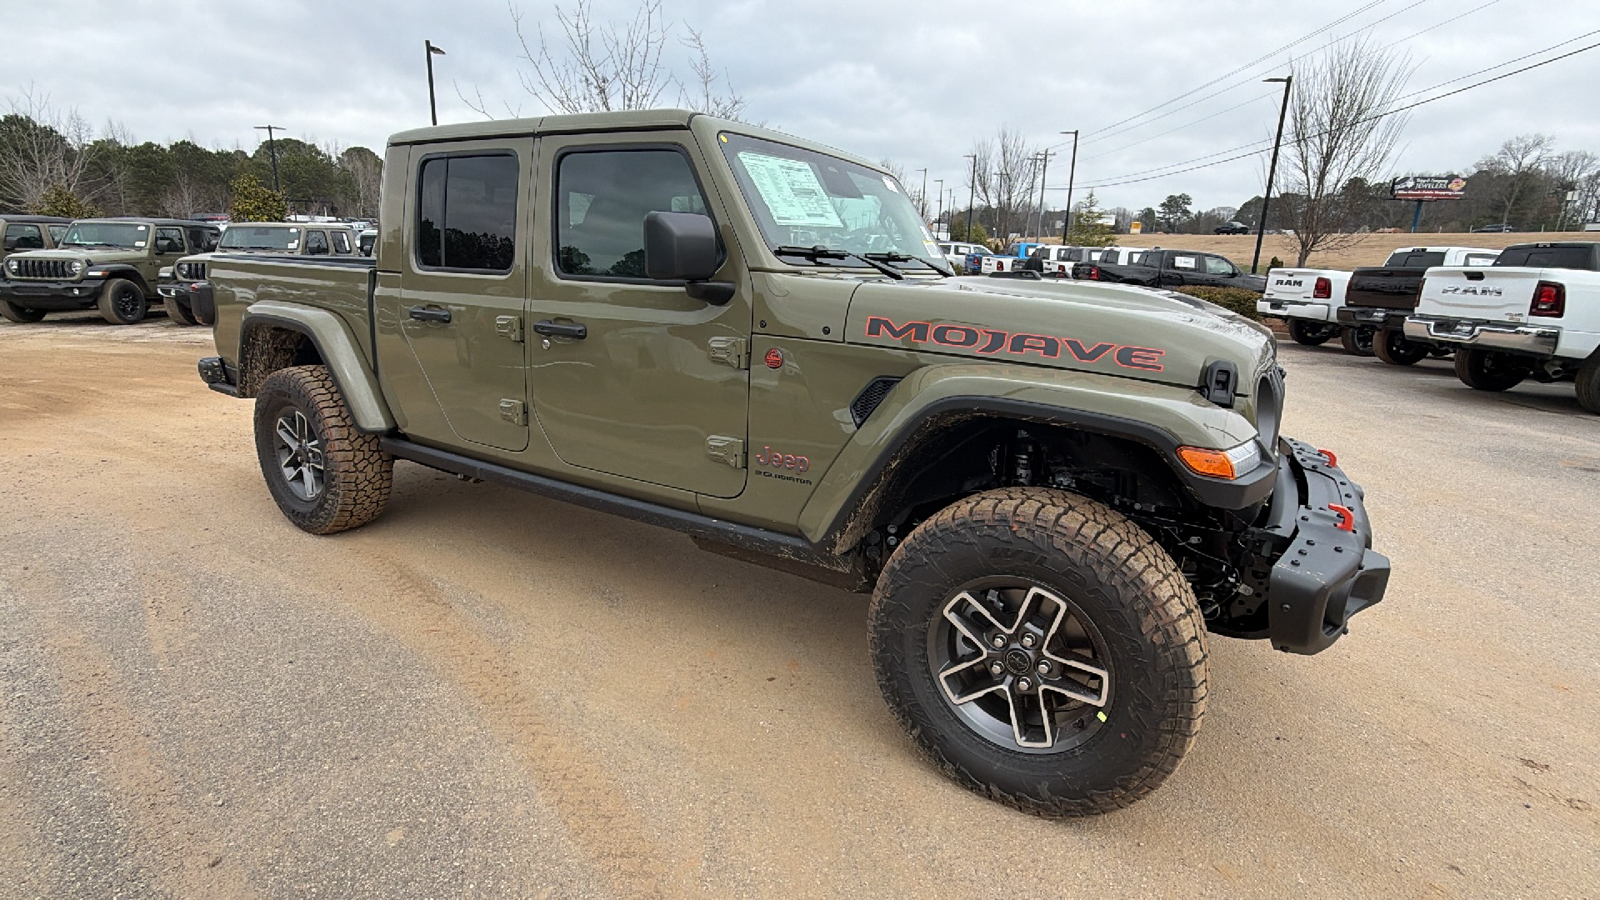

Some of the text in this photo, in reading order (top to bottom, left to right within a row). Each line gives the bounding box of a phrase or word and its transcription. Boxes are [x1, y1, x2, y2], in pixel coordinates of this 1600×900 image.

[1275, 279, 1303, 287] RAM
[1441, 285, 1503, 297] RAM
[866, 316, 1165, 371] MOJAVE
[756, 446, 810, 475] Jeep
[763, 471, 812, 486] GLADIATOR
